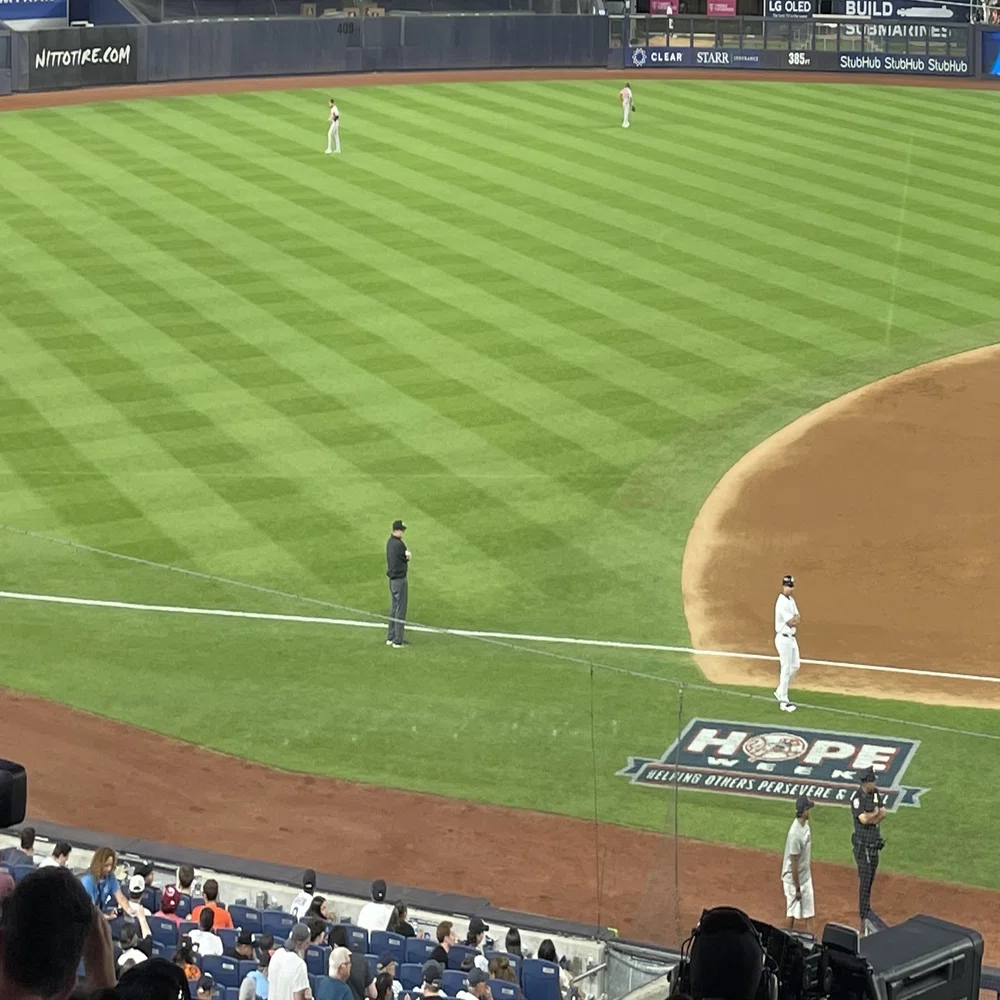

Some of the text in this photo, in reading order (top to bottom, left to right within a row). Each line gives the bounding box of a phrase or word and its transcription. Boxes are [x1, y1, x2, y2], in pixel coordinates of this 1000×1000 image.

[769, 0, 811, 13] LG OLED
[845, 1, 893, 17] BUILD
[35, 44, 131, 69] NITTOTIRE.COM
[651, 52, 683, 62] CLEAR
[697, 52, 729, 64] STARR
[788, 52, 805, 66] 385
[840, 55, 968, 73] StubHub StubHub StubHub
[646, 769, 702, 784] HELPING
[704, 774, 756, 791] OTHERS
[757, 779, 830, 800] PERSEVERE
[835, 788, 848, 800] &
